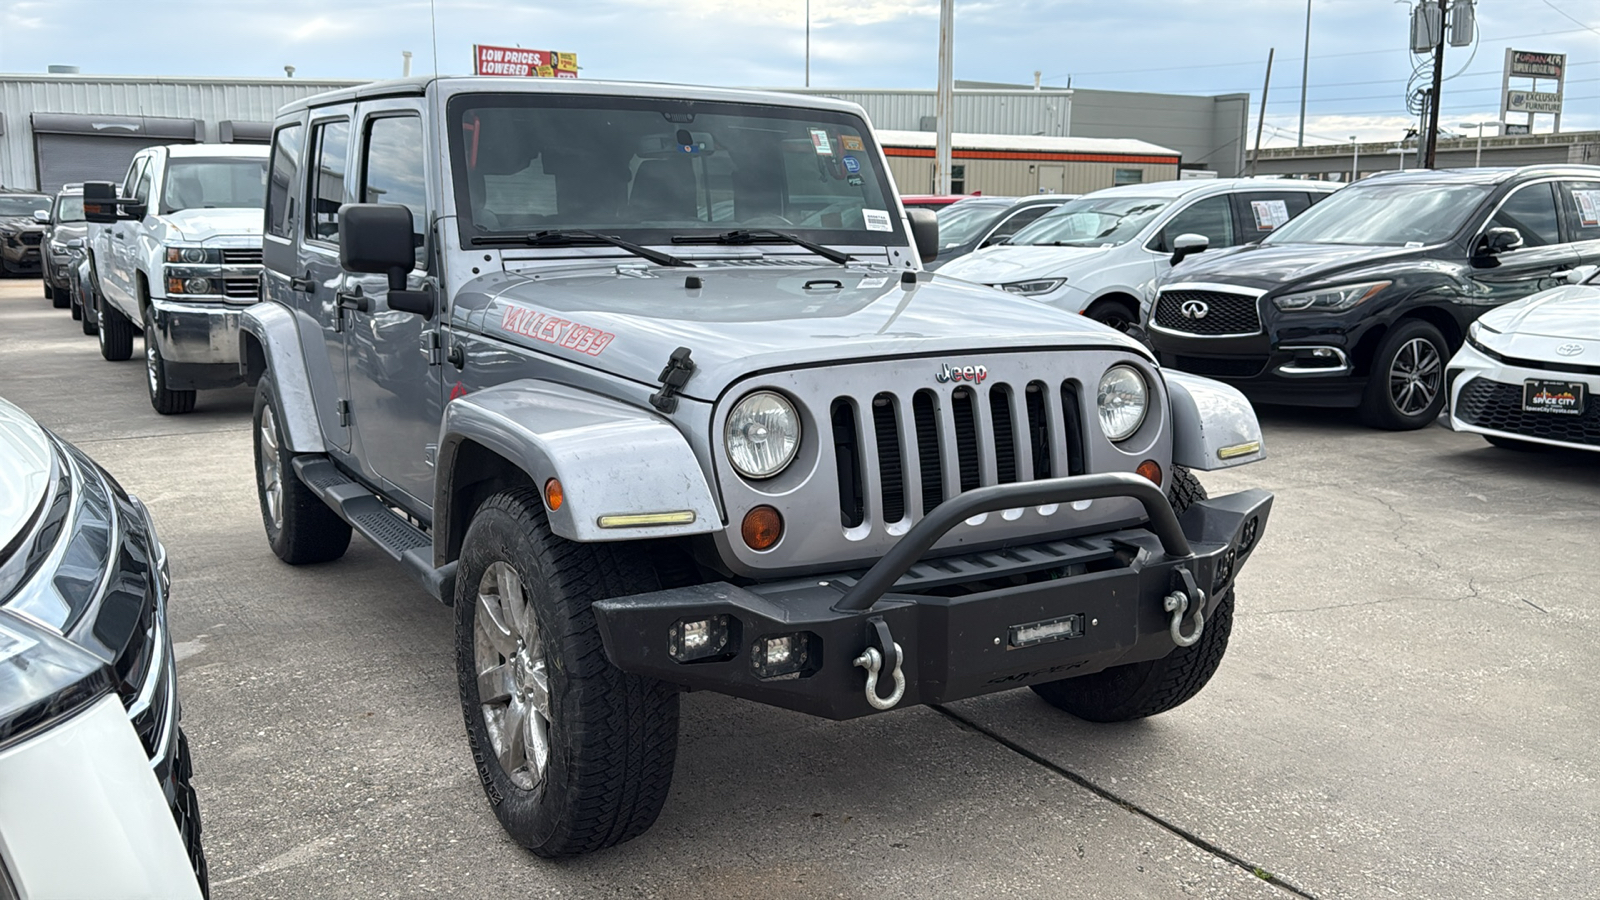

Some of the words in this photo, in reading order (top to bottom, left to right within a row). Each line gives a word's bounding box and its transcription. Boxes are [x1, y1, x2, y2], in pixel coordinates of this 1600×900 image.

[481, 49, 503, 60] LOW
[482, 62, 528, 75] LOWERED
[1526, 93, 1560, 102] EXCLUSIVE
[1525, 103, 1560, 111] FURNITURE
[935, 362, 987, 385] Jeep
[1533, 396, 1557, 404] SPACE
[1558, 398, 1576, 406] CITY
